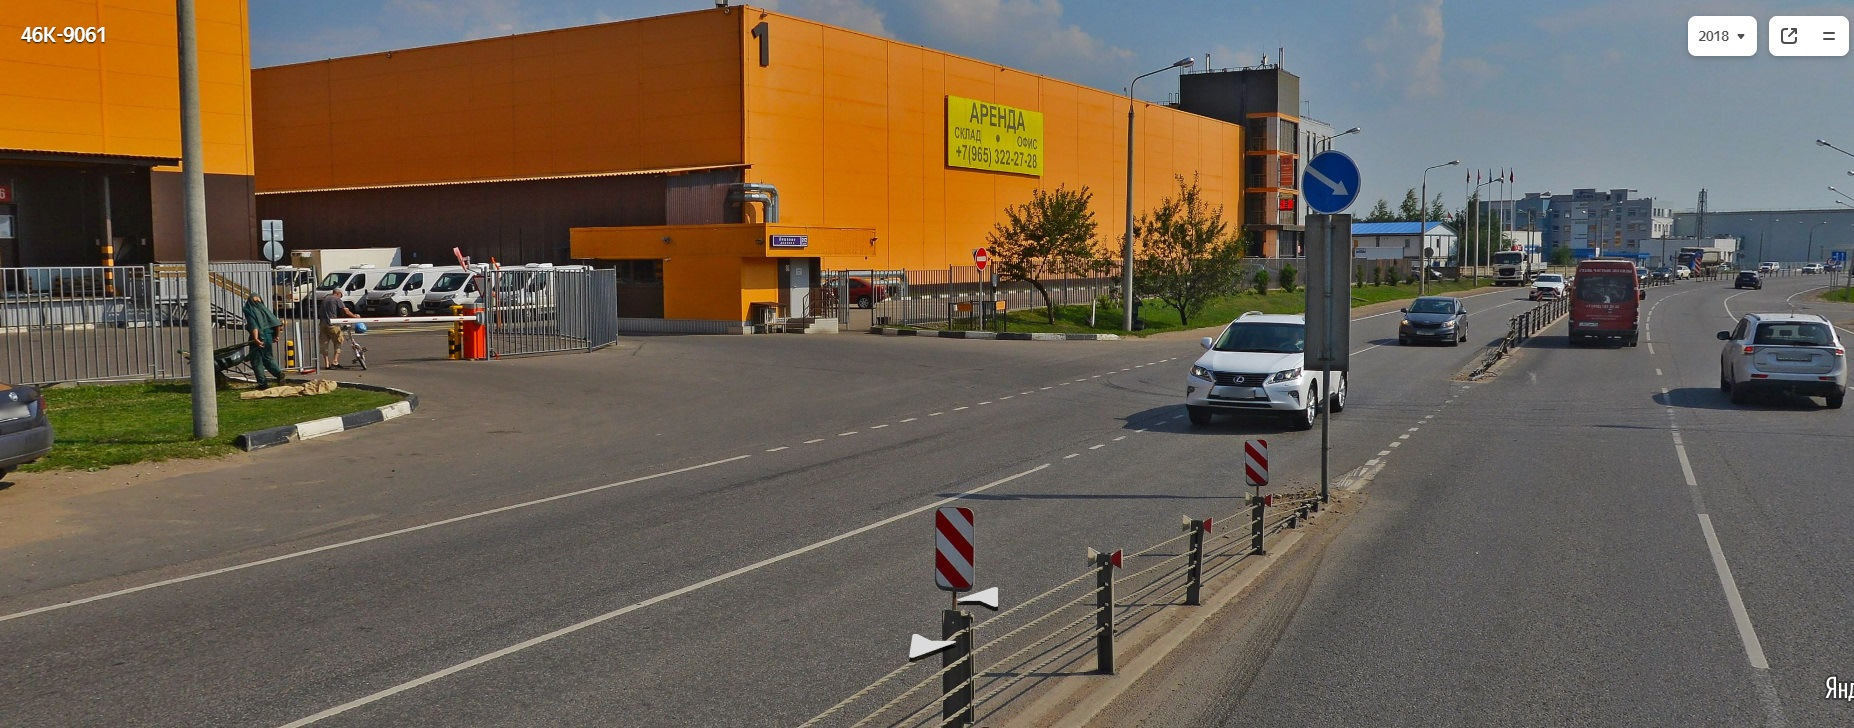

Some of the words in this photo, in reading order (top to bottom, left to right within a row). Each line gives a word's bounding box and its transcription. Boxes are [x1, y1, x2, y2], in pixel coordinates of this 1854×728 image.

[751, 22, 769, 67] 1
[969, 102, 1026, 133] АРЕНДА
[954, 126, 982, 144] СКЛАД
[1017, 136, 1038, 150] ОФИС
[955, 144, 992, 167] +7(965)
[994, 149, 1037, 169] 322-27-28
